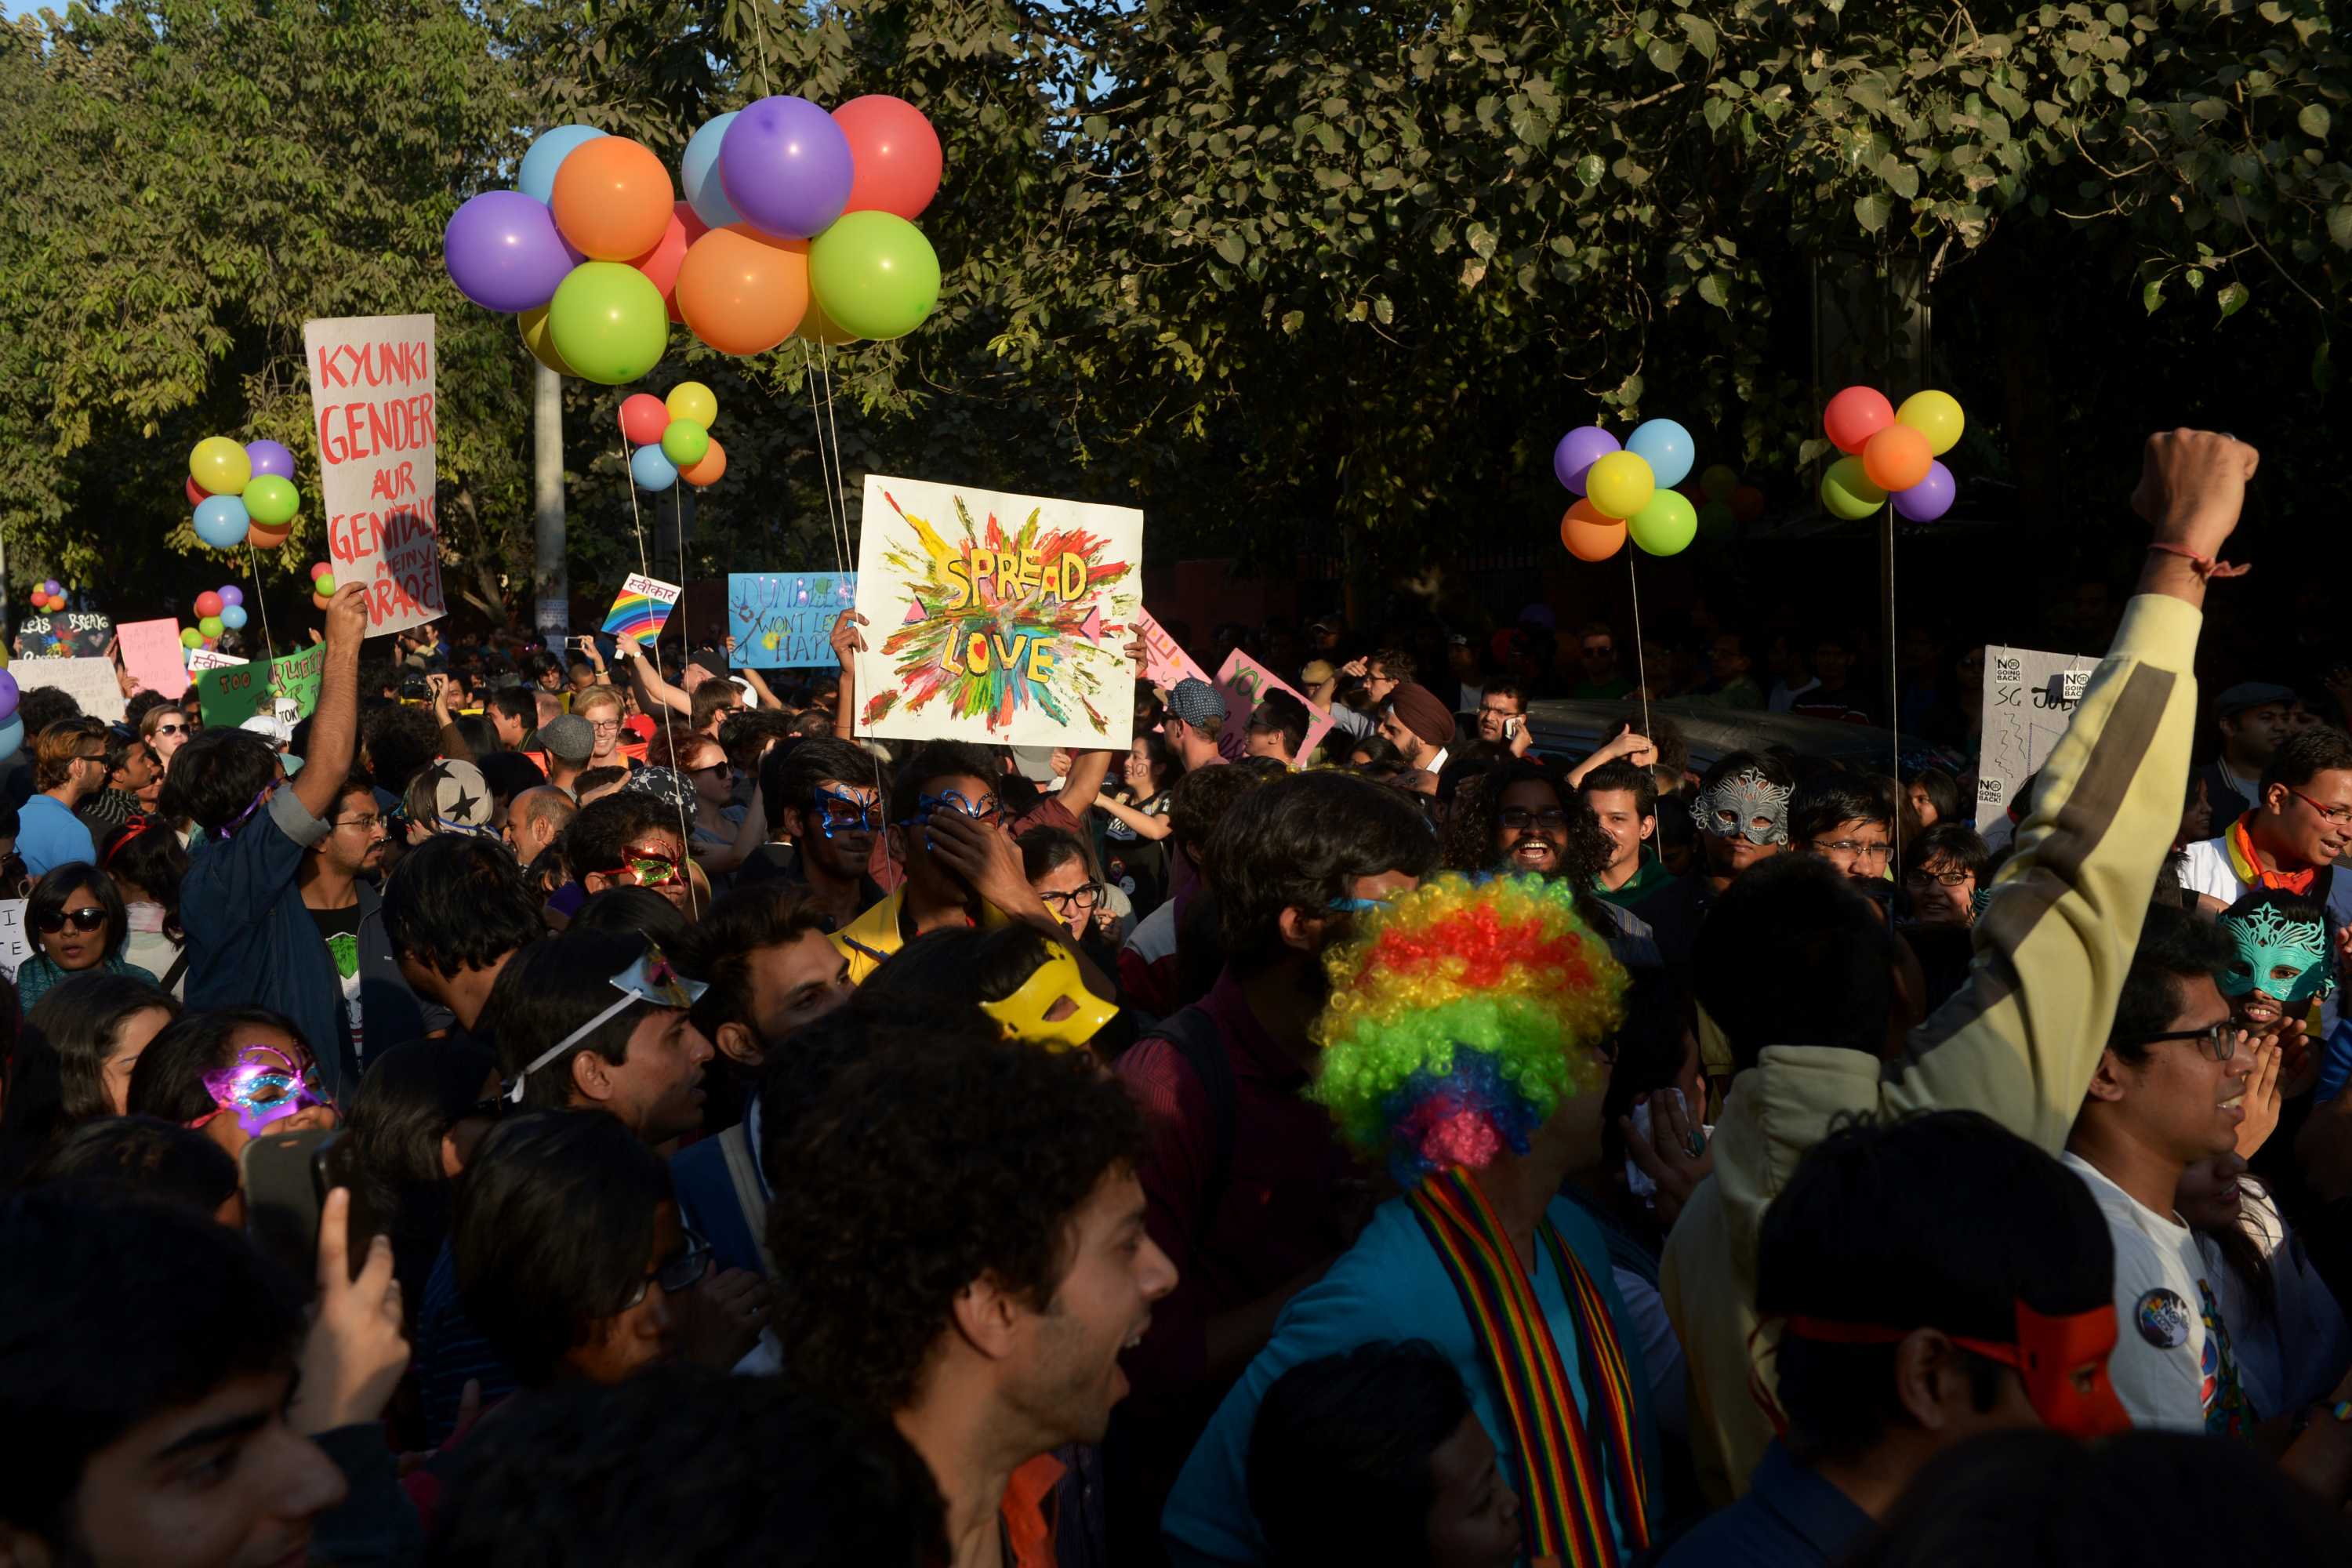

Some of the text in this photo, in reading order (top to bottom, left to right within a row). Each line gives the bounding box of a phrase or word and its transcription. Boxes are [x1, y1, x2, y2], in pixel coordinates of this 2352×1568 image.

[318, 340, 427, 389] KYUNKI
[320, 392, 436, 465] GENDER
[371, 461, 416, 499] AUR
[330, 495, 437, 565] GENITALS
[376, 550, 417, 579] MEIN
[942, 547, 1087, 611] SPREAD
[629, 579, 677, 602] स्वीकार
[939, 627, 1058, 684] LOVE
[1998, 659, 2020, 670] NO
[220, 671, 251, 695] TOO
[2066, 673, 2089, 684] NO
[1980, 779, 2001, 791] NO
